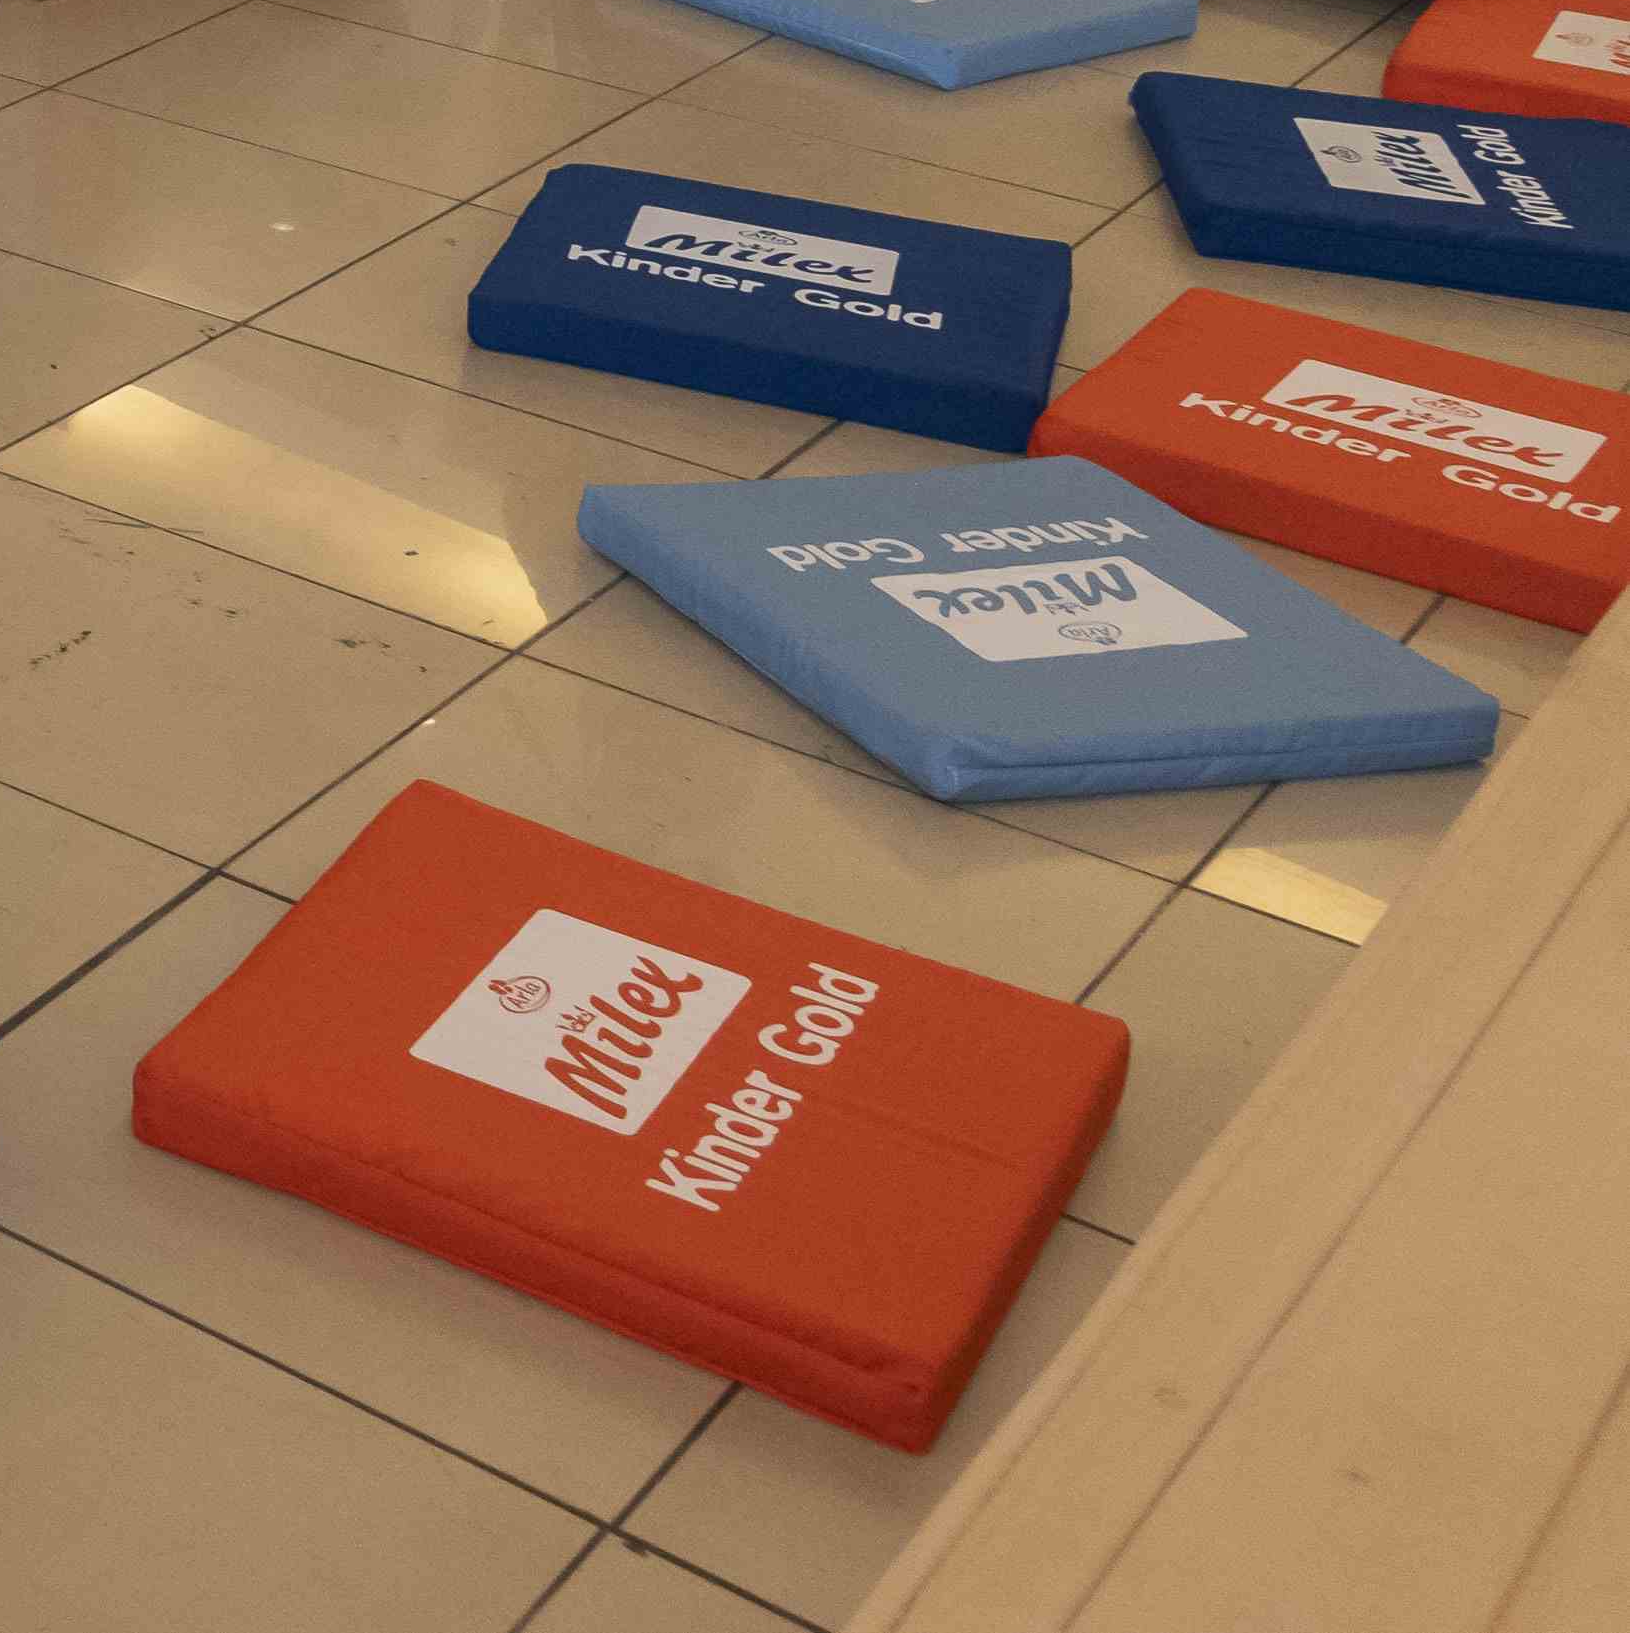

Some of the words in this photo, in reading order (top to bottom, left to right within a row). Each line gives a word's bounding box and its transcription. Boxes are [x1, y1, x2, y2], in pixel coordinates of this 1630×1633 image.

[1370, 129, 1473, 200] Milex
[1456, 123, 1526, 165] Gold
[1495, 169, 1575, 229] Kinder
[567, 243, 766, 294] Kinder
[793, 288, 943, 330] Gold
[641, 233, 878, 284] Milex
[1177, 392, 1412, 464] Kinder
[1441, 464, 1622, 524] Gold
[1284, 393, 1563, 468] Milex
[765, 537, 926, 573] Gold
[940, 516, 1149, 553] Kinder
[912, 562, 1139, 619] Milex
[510, 978, 543, 1011] Arla
[542, 954, 704, 1121] Milex
[644, 1068, 804, 1213] Kinder
[756, 960, 881, 1066] Gold
